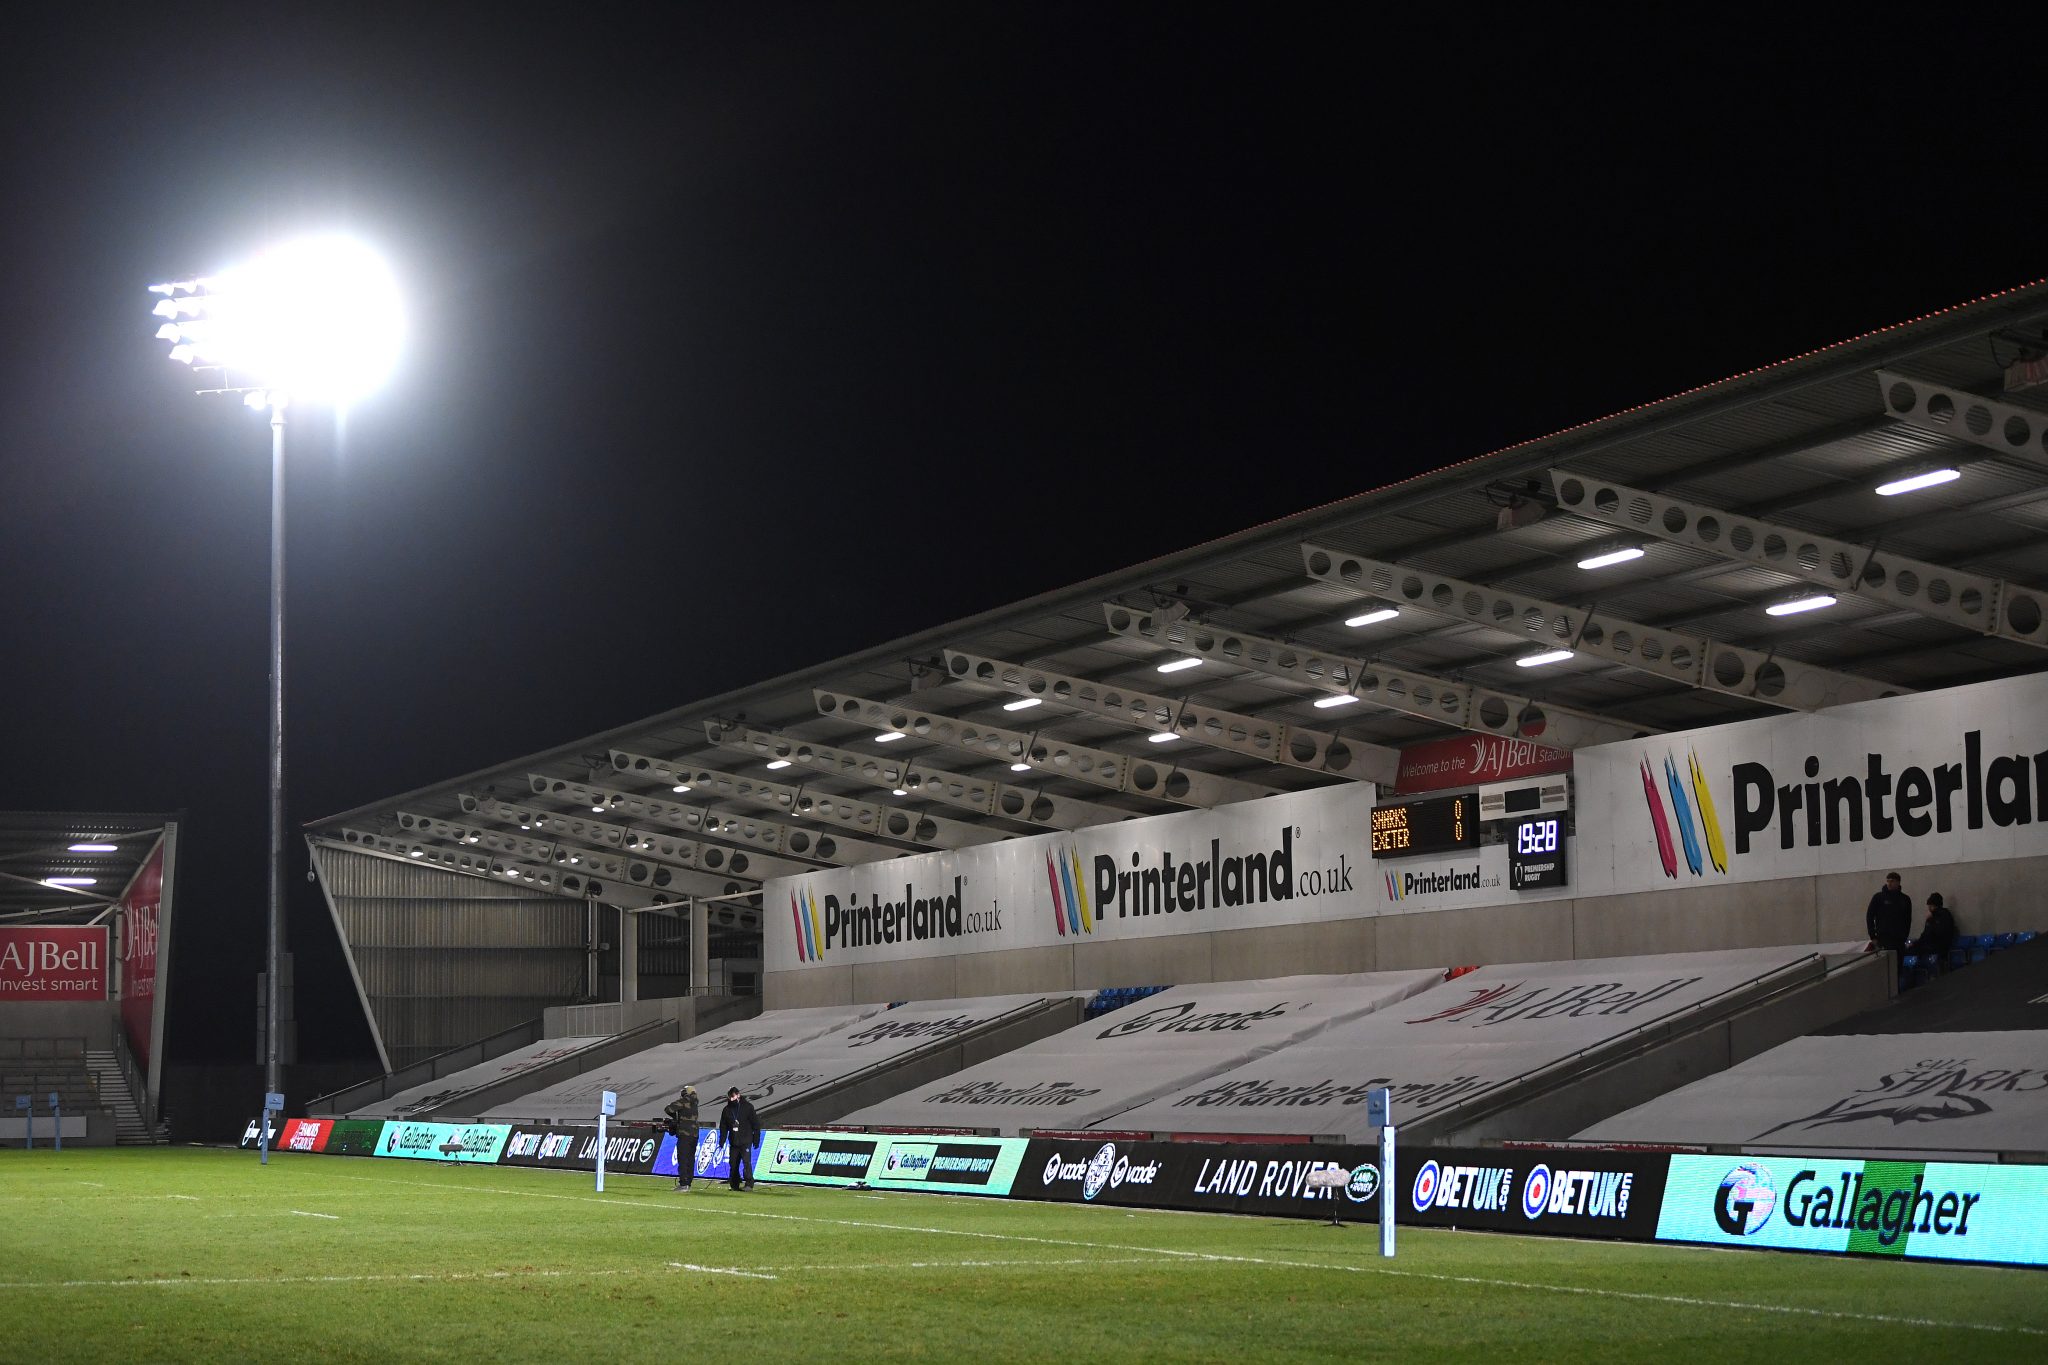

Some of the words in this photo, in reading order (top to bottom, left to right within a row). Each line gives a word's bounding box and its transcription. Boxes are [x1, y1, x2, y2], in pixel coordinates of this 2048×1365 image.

[1402, 764, 1439, 778] Welcome
[1440, 760, 1450, 772] to
[1451, 756, 1466, 771] the
[1372, 808, 1407, 830] SHARKS
[1454, 800, 1462, 819] 0
[1372, 828, 1410, 851] EXETER
[1455, 821, 1463, 841] 0
[1518, 820, 1557, 854] 19:28
[1524, 863, 1555, 873] PREMIERSHIP
[1524, 873, 1541, 882] RUGBY
[50, 979, 98, 991] smart
[400, 1126, 437, 1155] Gallagher
[788, 1149, 814, 1166] Gallagher
[900, 1153, 930, 1172] Gallagher
[1194, 1159, 1258, 1197] LAND
[1783, 1170, 1981, 1246] Gallagher
